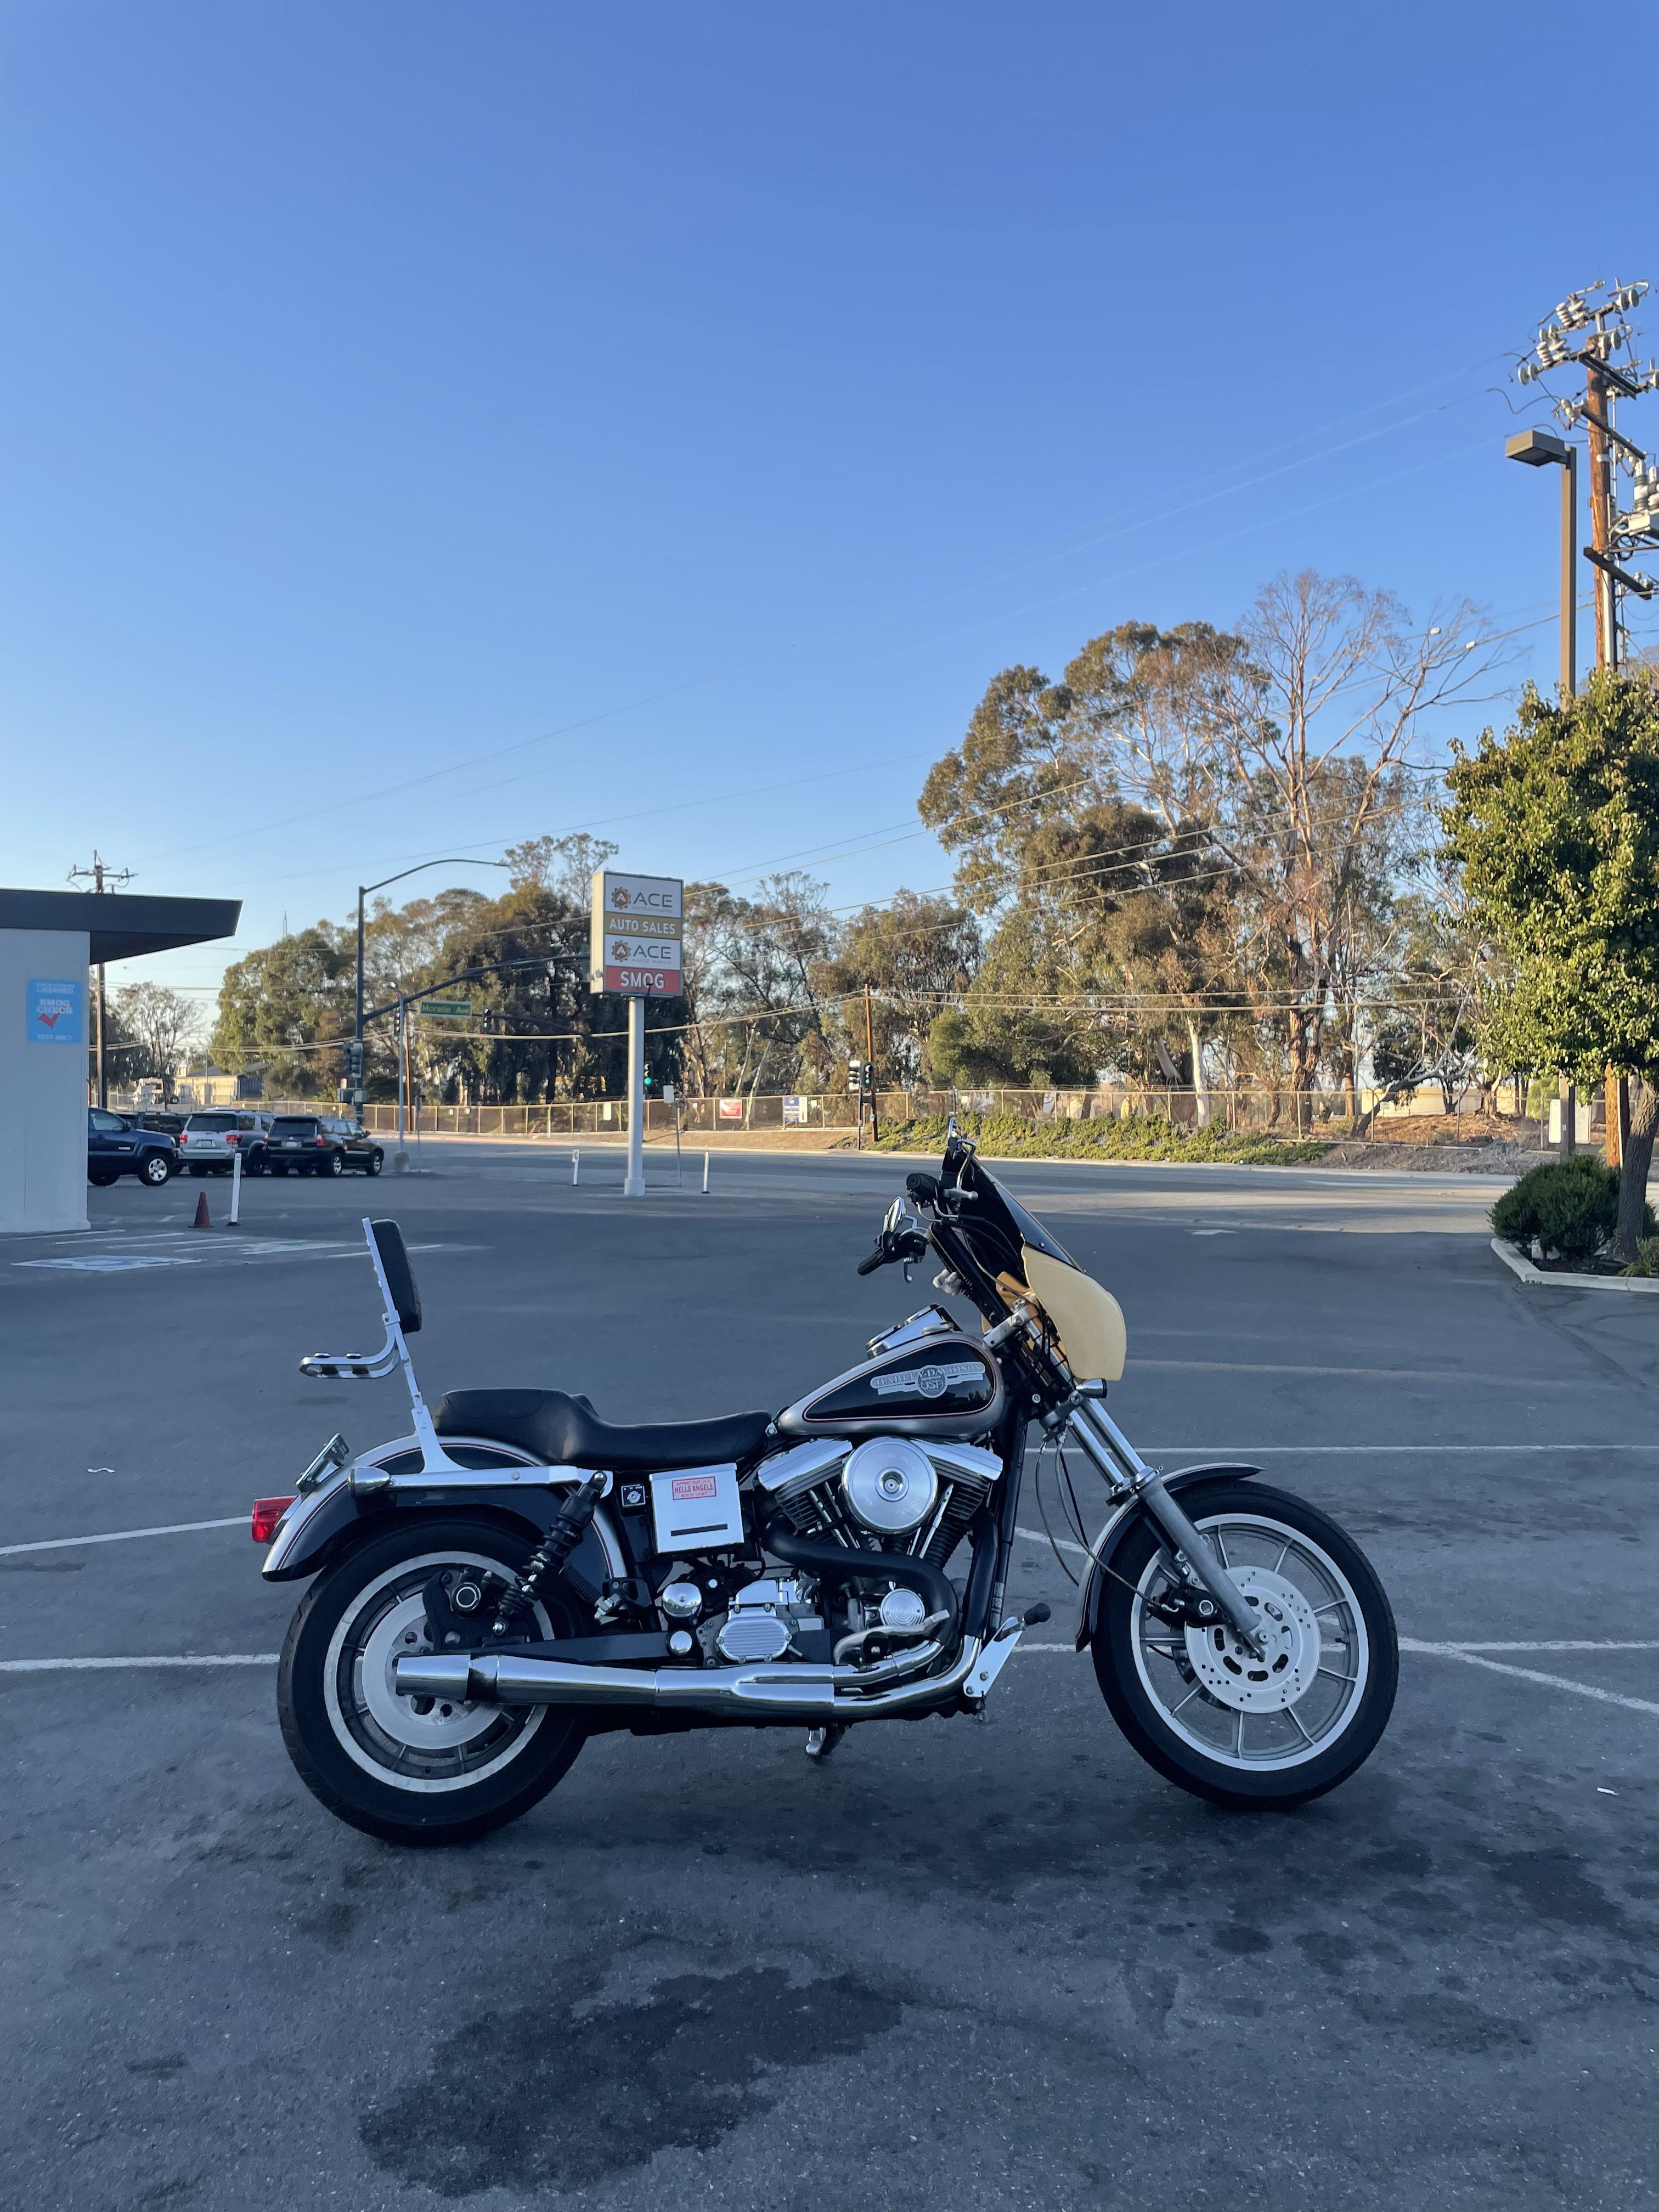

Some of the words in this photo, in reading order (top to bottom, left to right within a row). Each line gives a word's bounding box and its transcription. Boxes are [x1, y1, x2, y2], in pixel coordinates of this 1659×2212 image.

[633, 891, 673, 907] ACE
[610, 918, 639, 931] AUTO
[642, 921, 675, 934] SALES
[633, 944, 671, 959] ACE
[620, 970, 664, 990] SMOG
[693, 1483, 713, 1492] ANGELS
